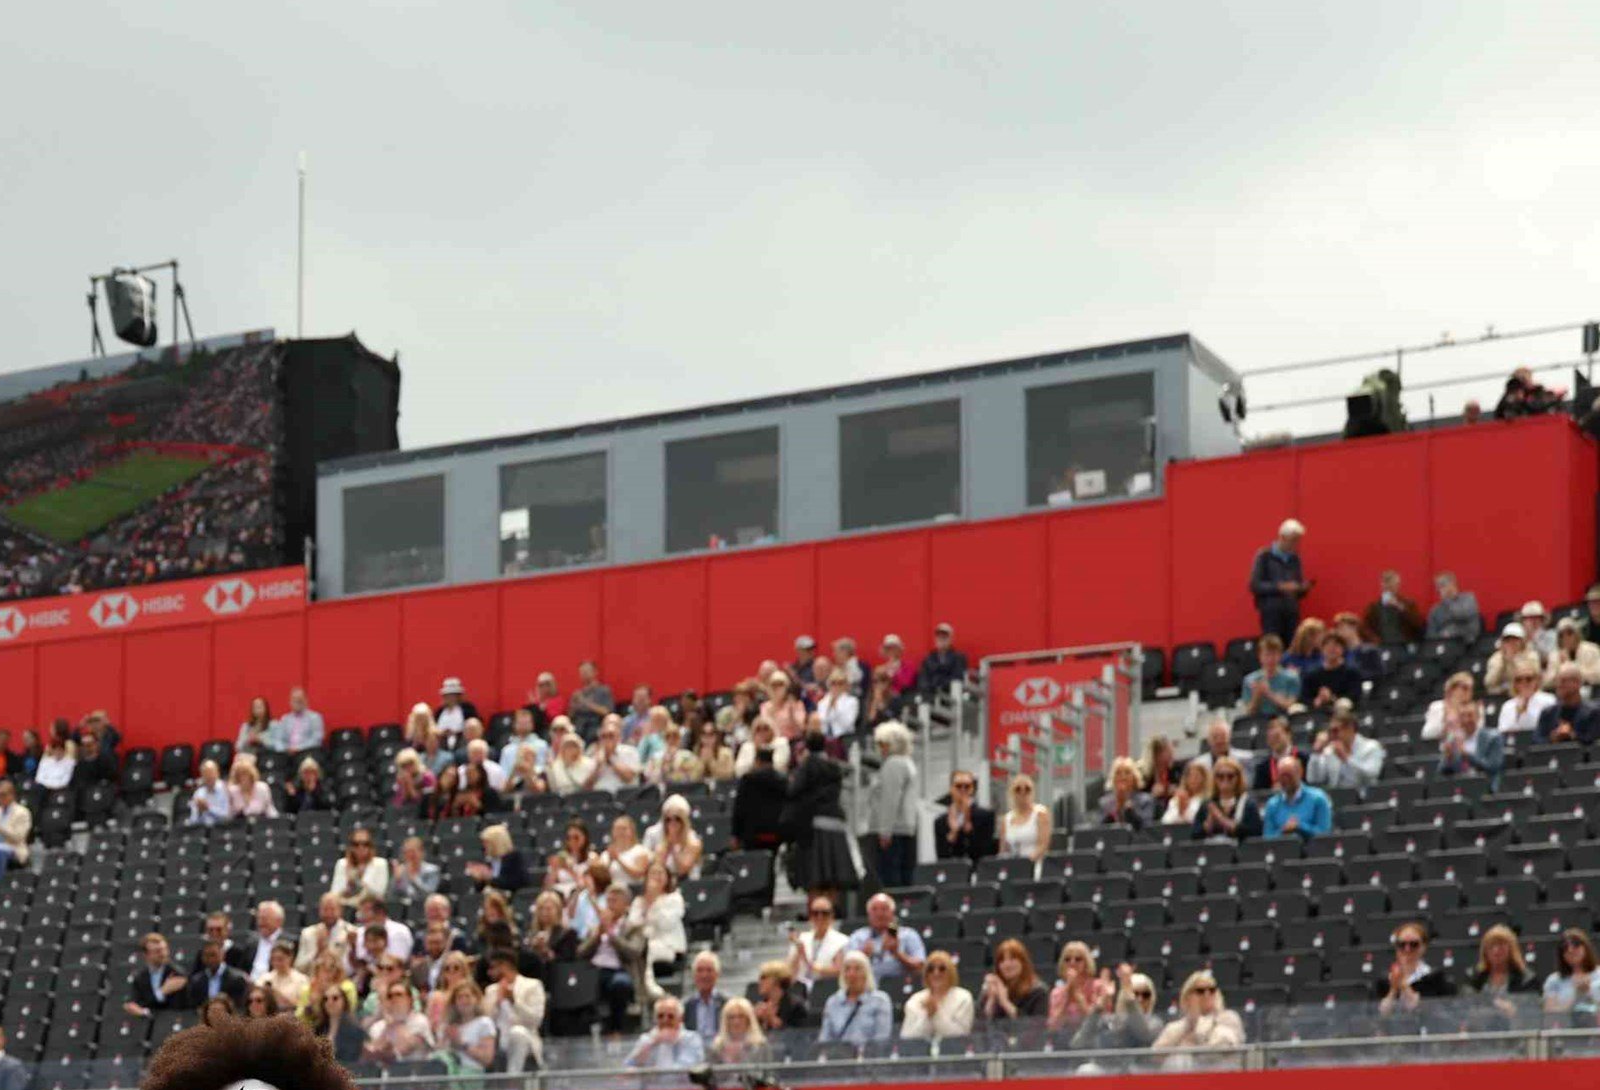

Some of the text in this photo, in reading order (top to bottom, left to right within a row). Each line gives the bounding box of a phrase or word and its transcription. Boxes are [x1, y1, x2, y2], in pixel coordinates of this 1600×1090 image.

[259, 579, 303, 600] HSBC
[143, 594, 185, 613] HSBC
[29, 609, 70, 627] HSBC
